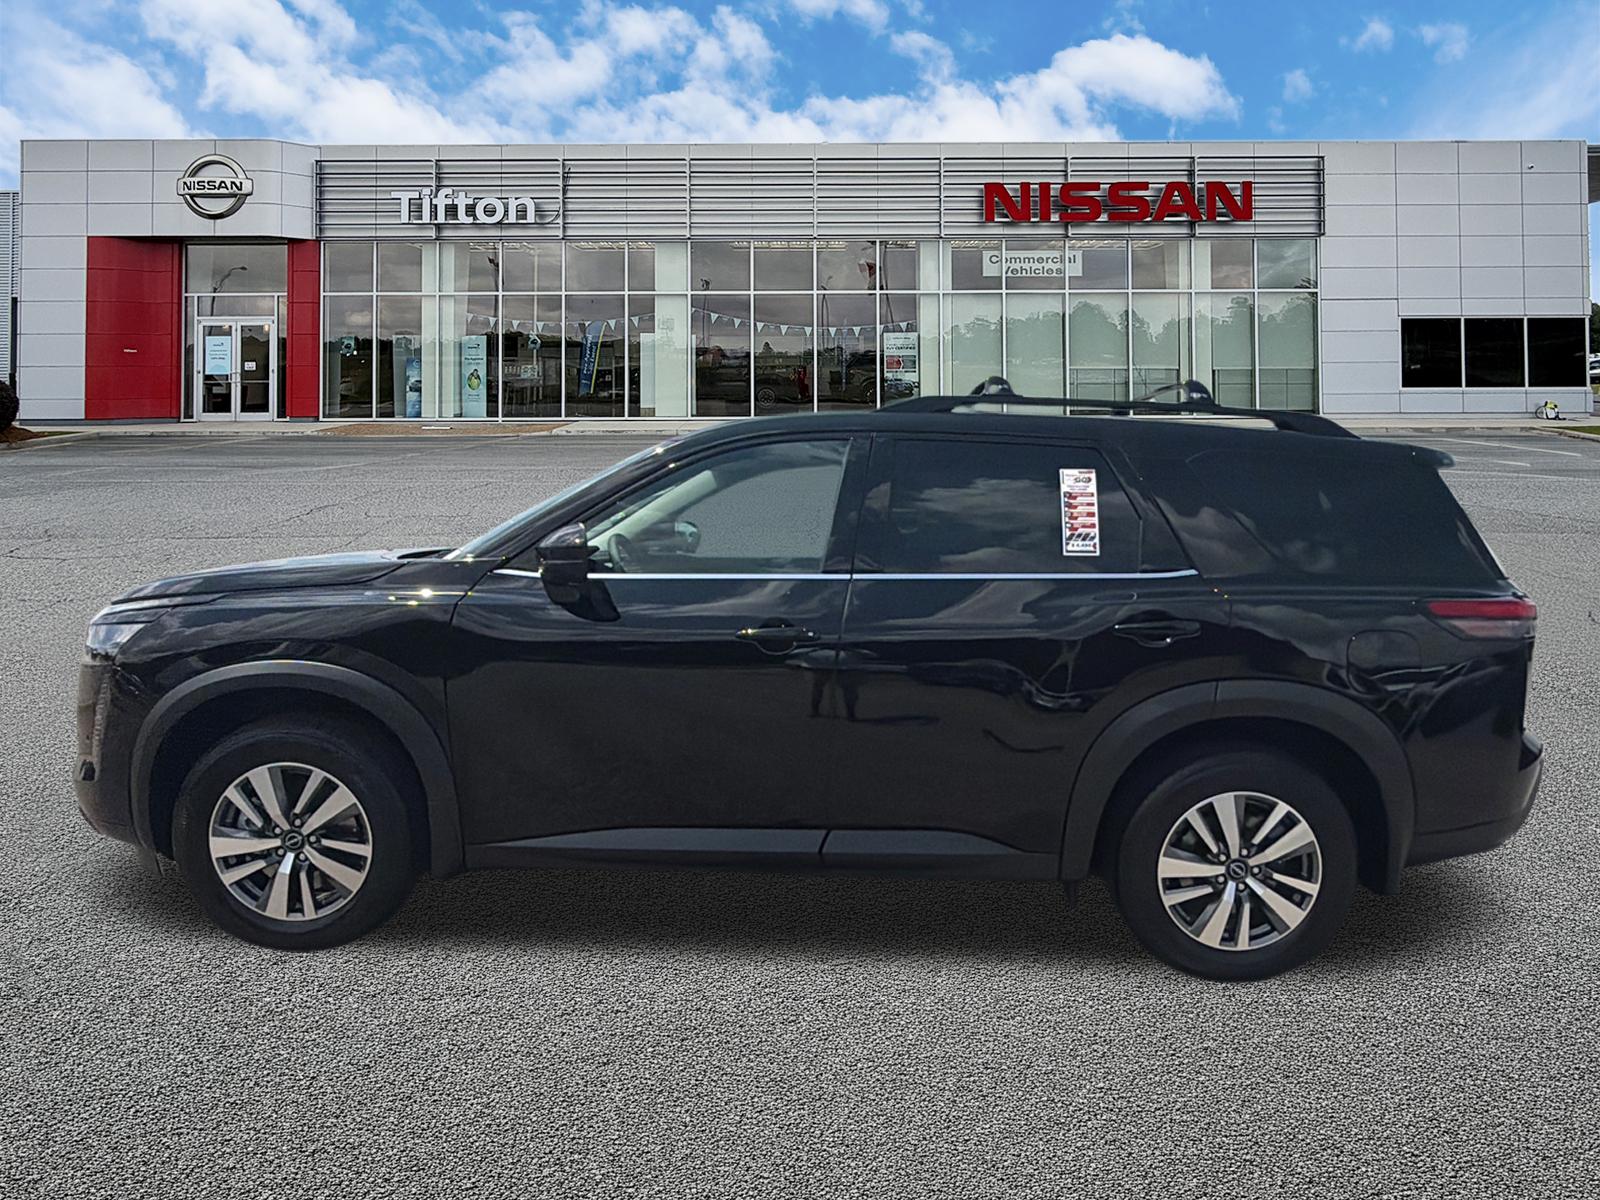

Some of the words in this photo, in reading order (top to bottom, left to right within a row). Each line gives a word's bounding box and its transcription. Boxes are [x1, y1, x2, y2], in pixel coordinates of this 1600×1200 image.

[183, 181, 243, 191] NISSAN
[983, 181, 1253, 222] NISSAN
[391, 188, 536, 224] Tifton
